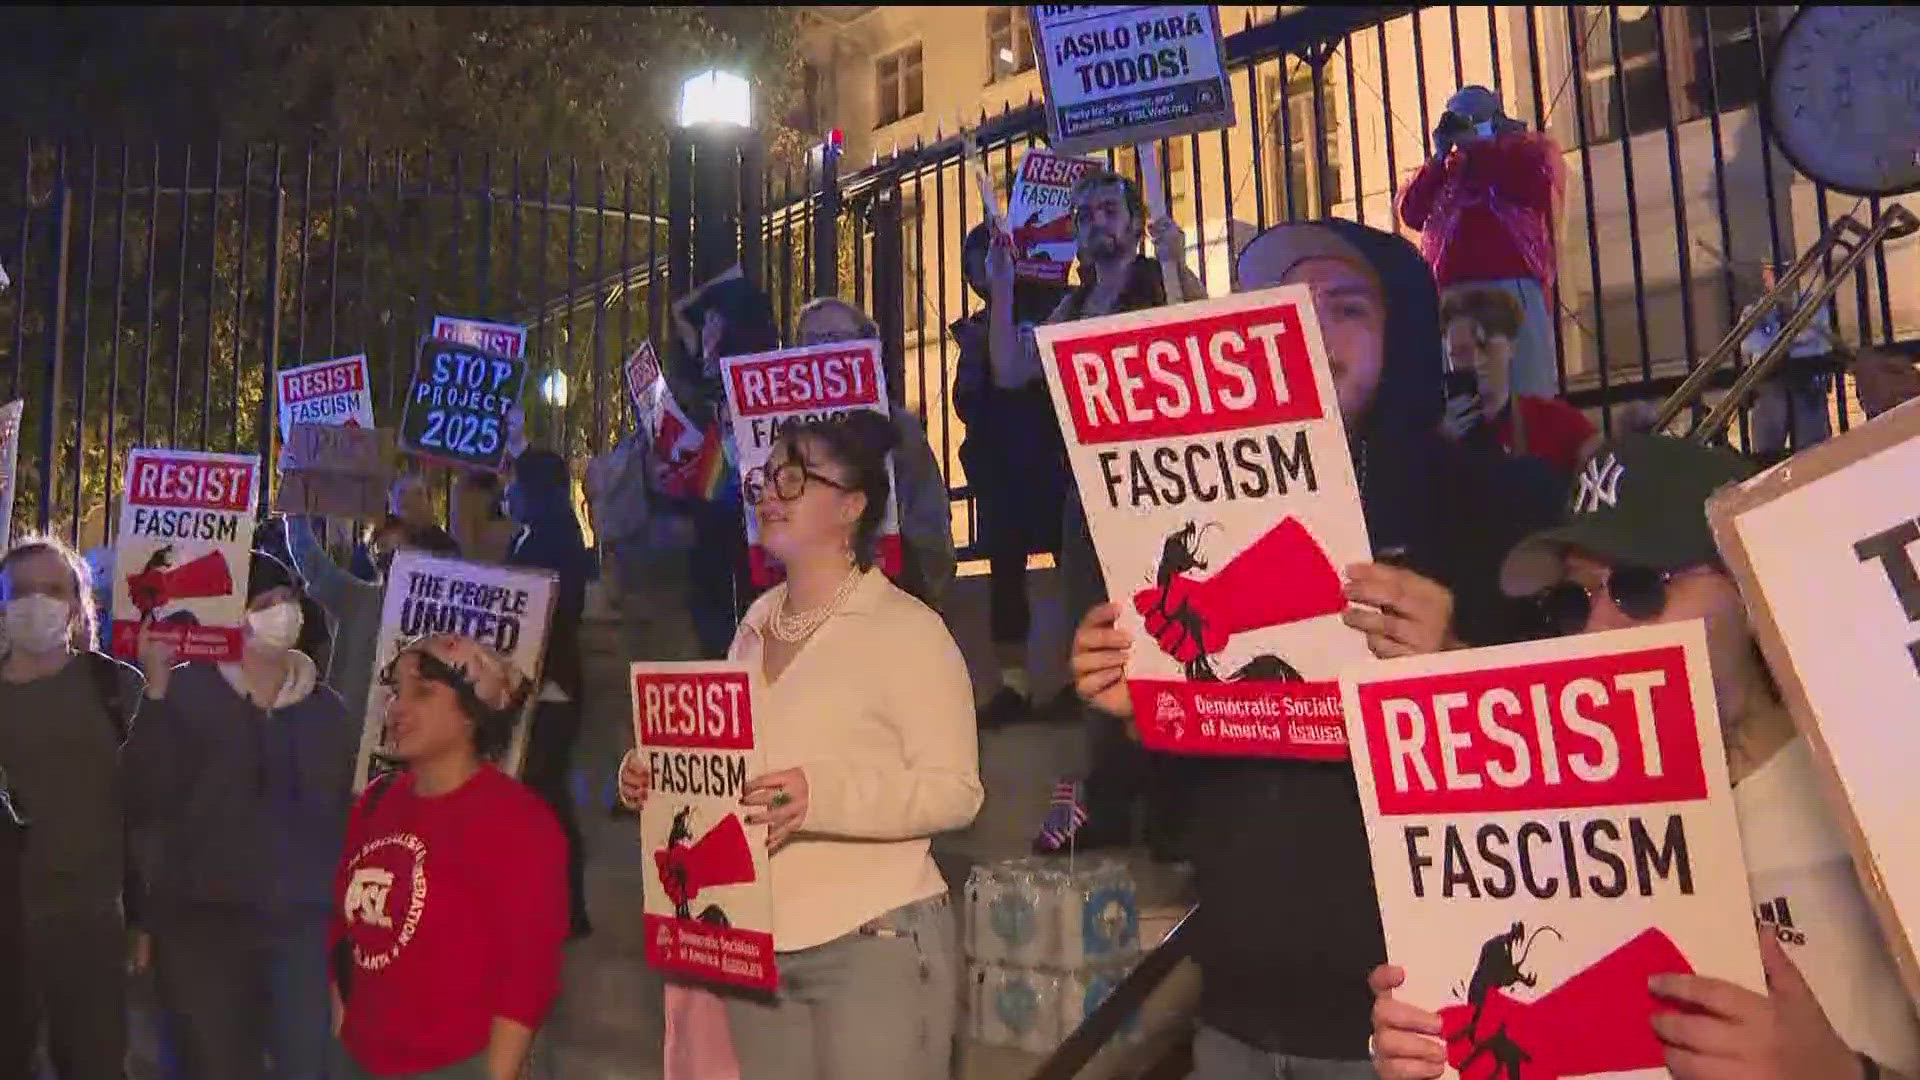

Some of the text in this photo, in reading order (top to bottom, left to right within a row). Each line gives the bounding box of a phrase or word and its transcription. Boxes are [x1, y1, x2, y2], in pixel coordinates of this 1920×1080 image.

[1136, 12, 1204, 44] PARA
[1076, 45, 1190, 94] TODOS!
[1026, 156, 1084, 182] RESIS
[1021, 184, 1072, 207] FASCIS
[288, 365, 357, 400] RESIST
[433, 353, 512, 390] STOP
[740, 357, 865, 407] RESIST
[1072, 323, 1292, 428] RESIST
[290, 394, 361, 424] FASCISM
[417, 383, 512, 415] PROJECT
[420, 409, 499, 454] 2025
[139, 463, 248, 503] RESIST
[1099, 429, 1318, 508] FASCISM
[1573, 453, 1626, 514] NY
[133, 508, 239, 542] FASCISM
[408, 571, 529, 614] THE PEOPLE
[401, 597, 521, 653] UNITED
[645, 682, 742, 738] RESIST
[1194, 694, 1344, 717] Democratic Sociali
[1201, 720, 1346, 744] of America dsausa
[1380, 670, 1666, 793] RESIST
[650, 752, 746, 797] FASCISM
[1404, 814, 1695, 898] FASCISM
